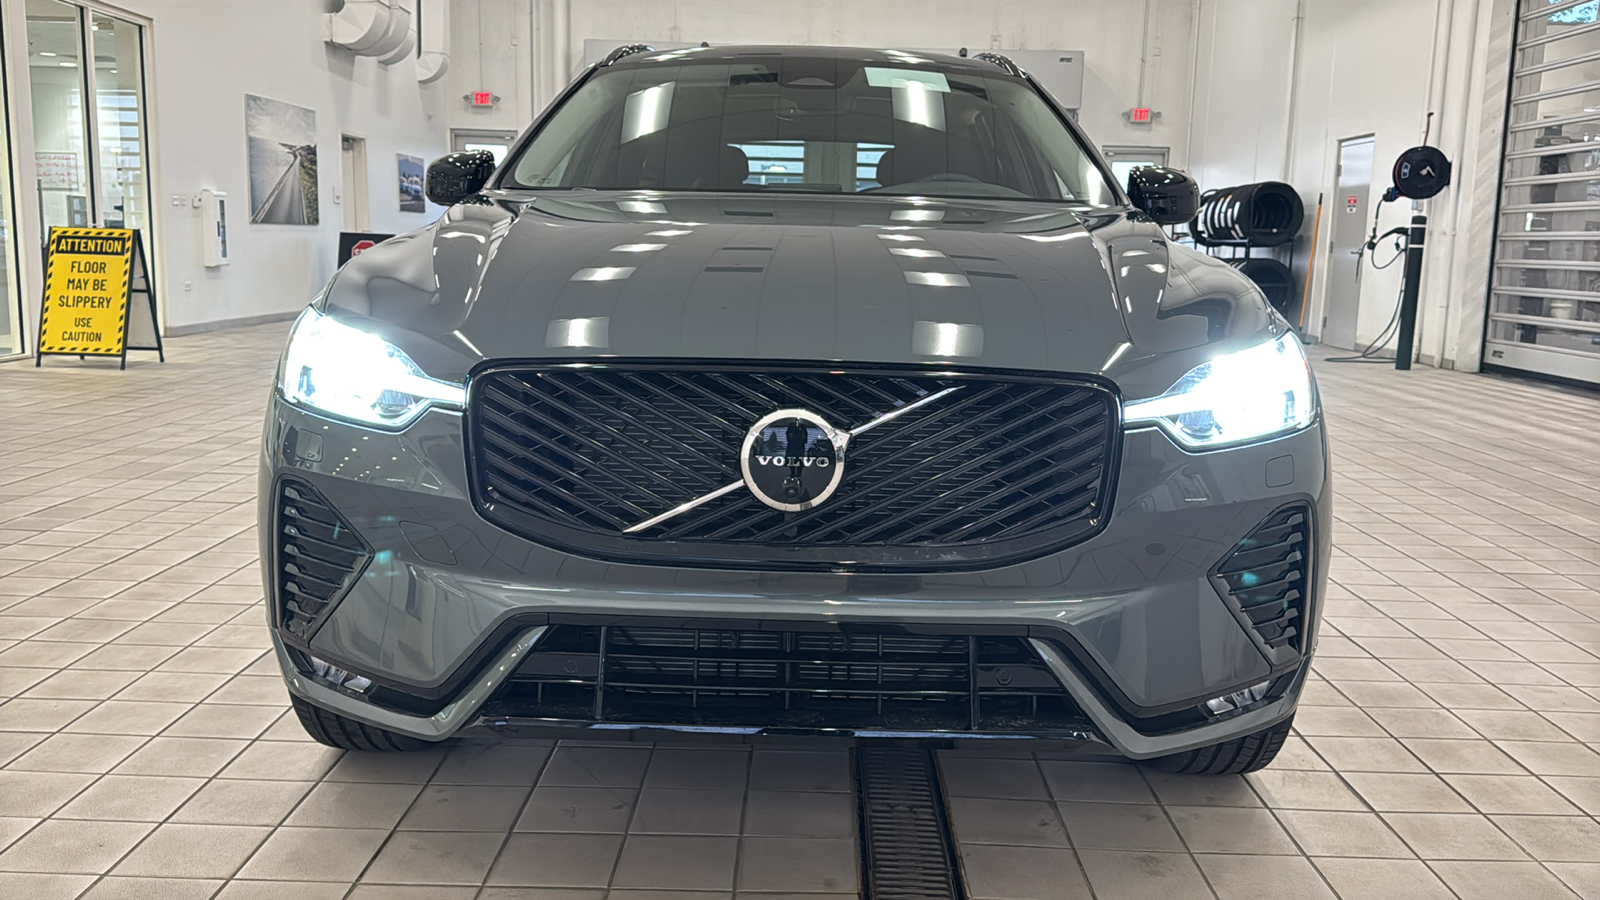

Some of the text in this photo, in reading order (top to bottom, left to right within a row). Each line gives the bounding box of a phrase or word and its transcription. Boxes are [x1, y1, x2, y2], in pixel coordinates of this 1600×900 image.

[474, 92, 490, 105] EXIT
[58, 238, 123, 253] ATTENTION
[70, 261, 107, 274] FLOOR
[66, 278, 108, 291] MAY BE
[58, 295, 112, 309] SLIPPERY
[74, 317, 93, 328] USE
[61, 331, 102, 342] CAUTION
[755, 455, 830, 468] VOLVO
